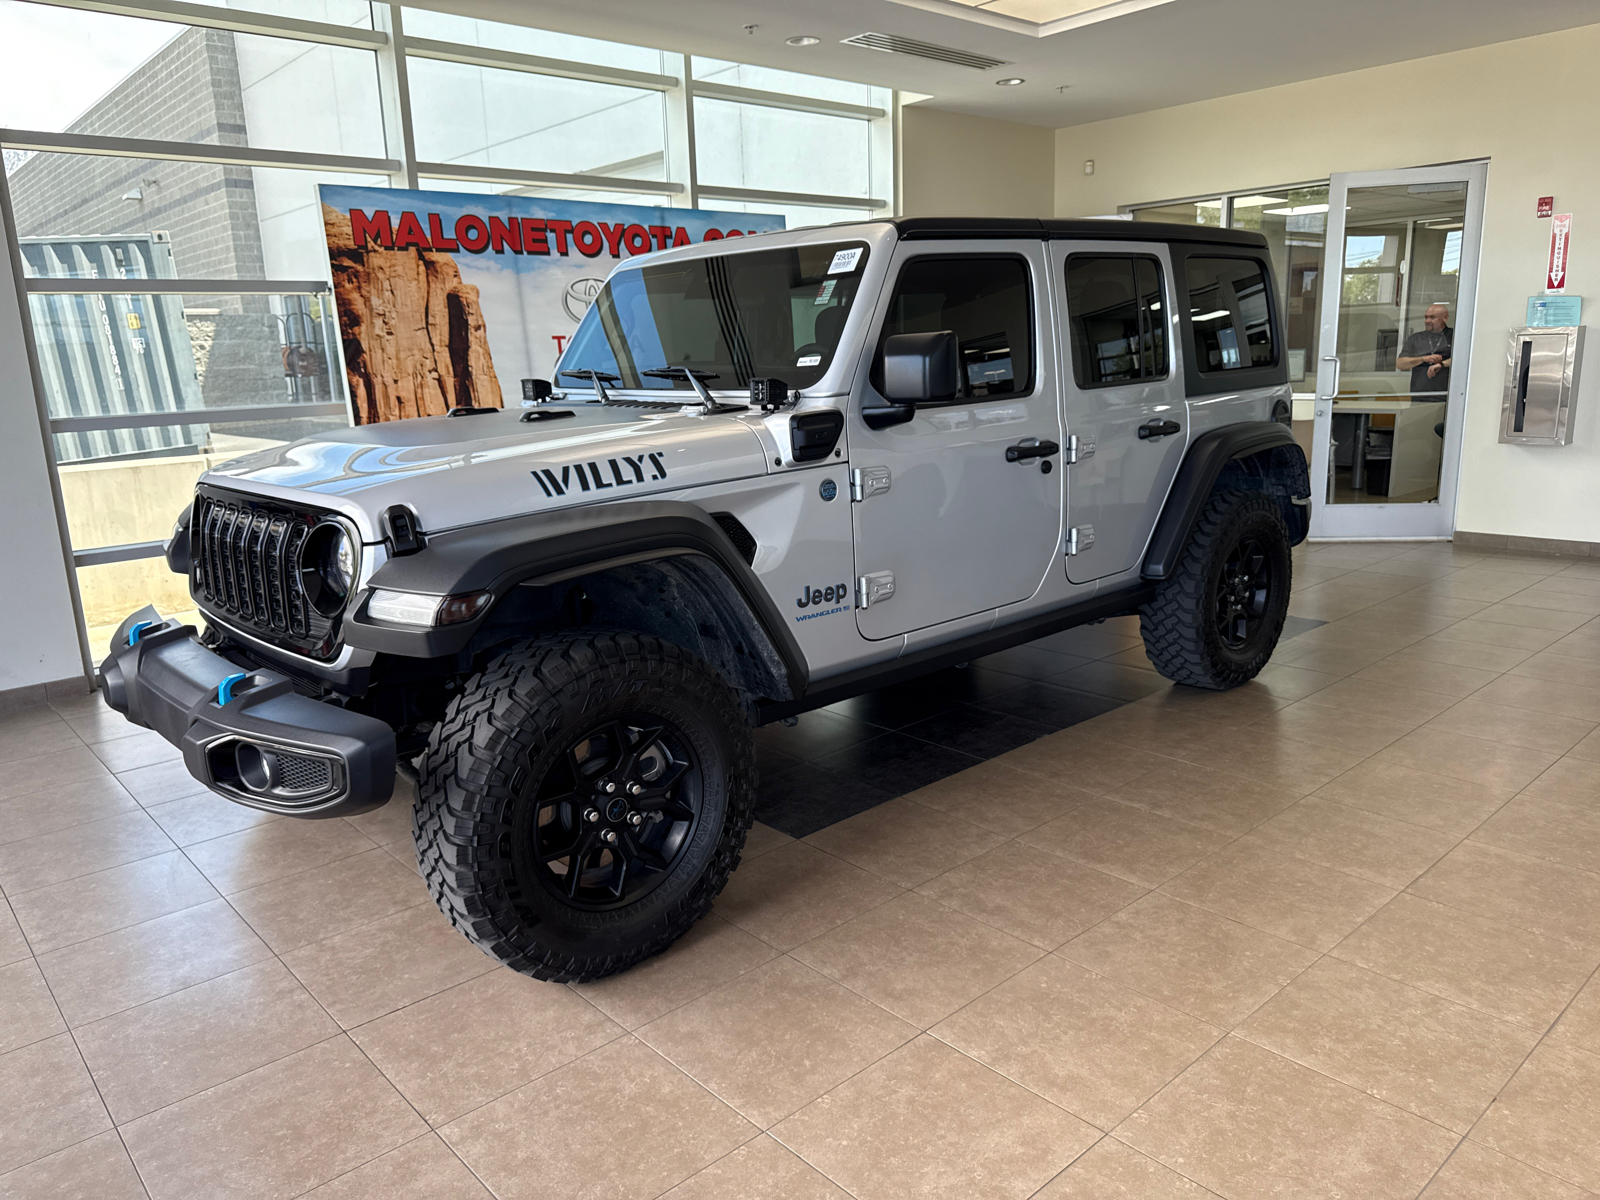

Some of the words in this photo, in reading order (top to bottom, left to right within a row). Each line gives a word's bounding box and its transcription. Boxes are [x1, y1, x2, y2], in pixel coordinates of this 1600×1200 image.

[530, 451, 668, 498] WILLYS
[796, 582, 848, 609] Jeep
[795, 606, 842, 623] WRANGLER
